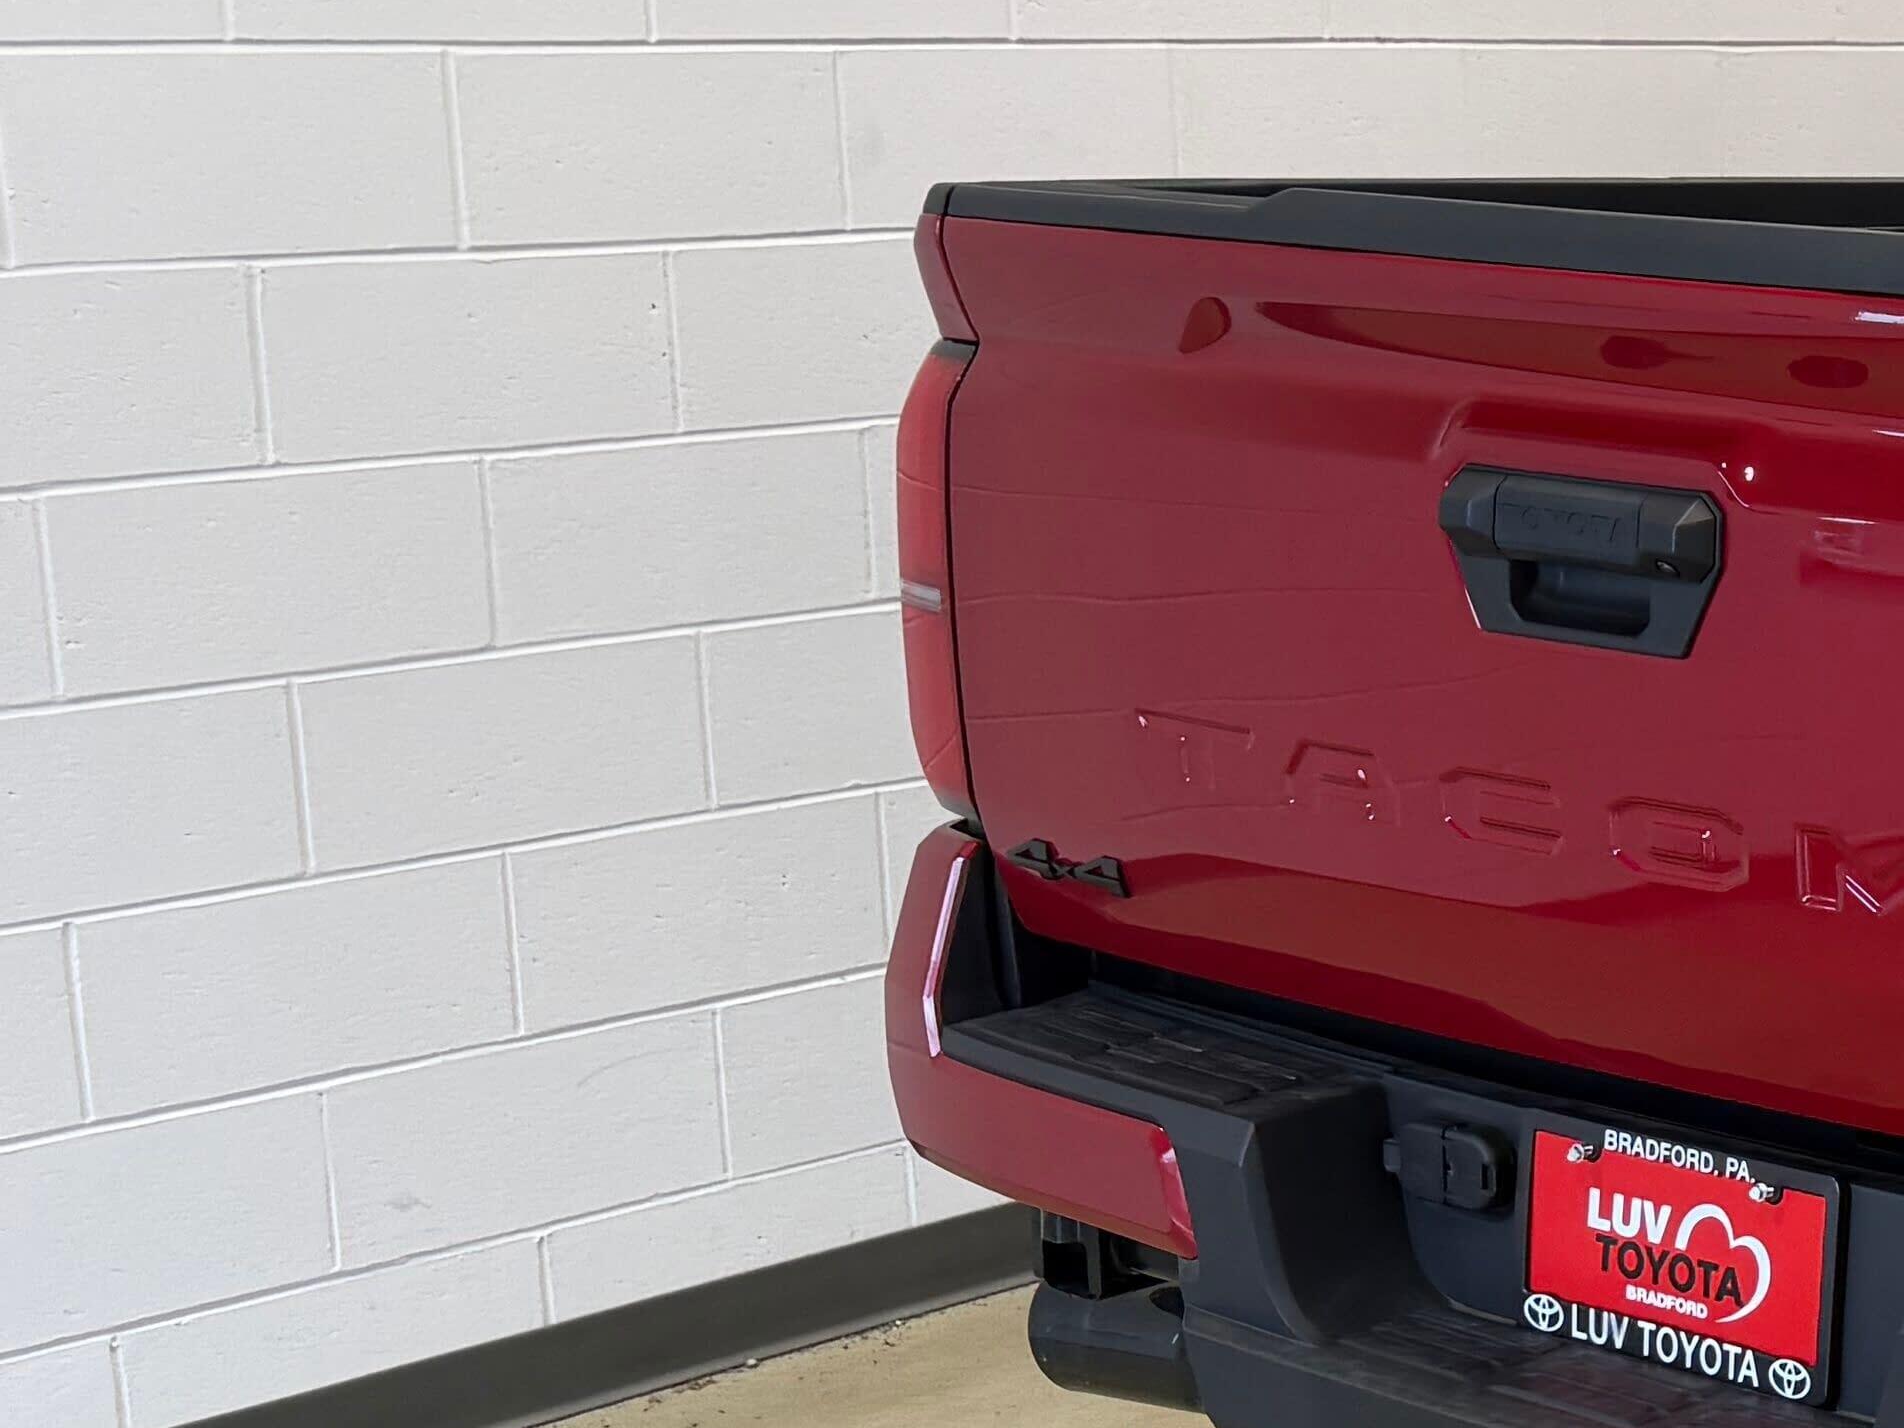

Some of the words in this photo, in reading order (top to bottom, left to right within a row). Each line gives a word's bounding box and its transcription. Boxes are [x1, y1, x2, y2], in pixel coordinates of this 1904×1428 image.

[1603, 1128, 1719, 1176] BRADFORD,
[1725, 1157, 1756, 1184] PA.
[1586, 1185, 1672, 1245] LUV
[1595, 1233, 1745, 1309] TOYOTA
[1625, 1283, 1709, 1320] BRADFORD
[1570, 1303, 1630, 1350] LUV
[1637, 1320, 1760, 1388] TOYOTA
